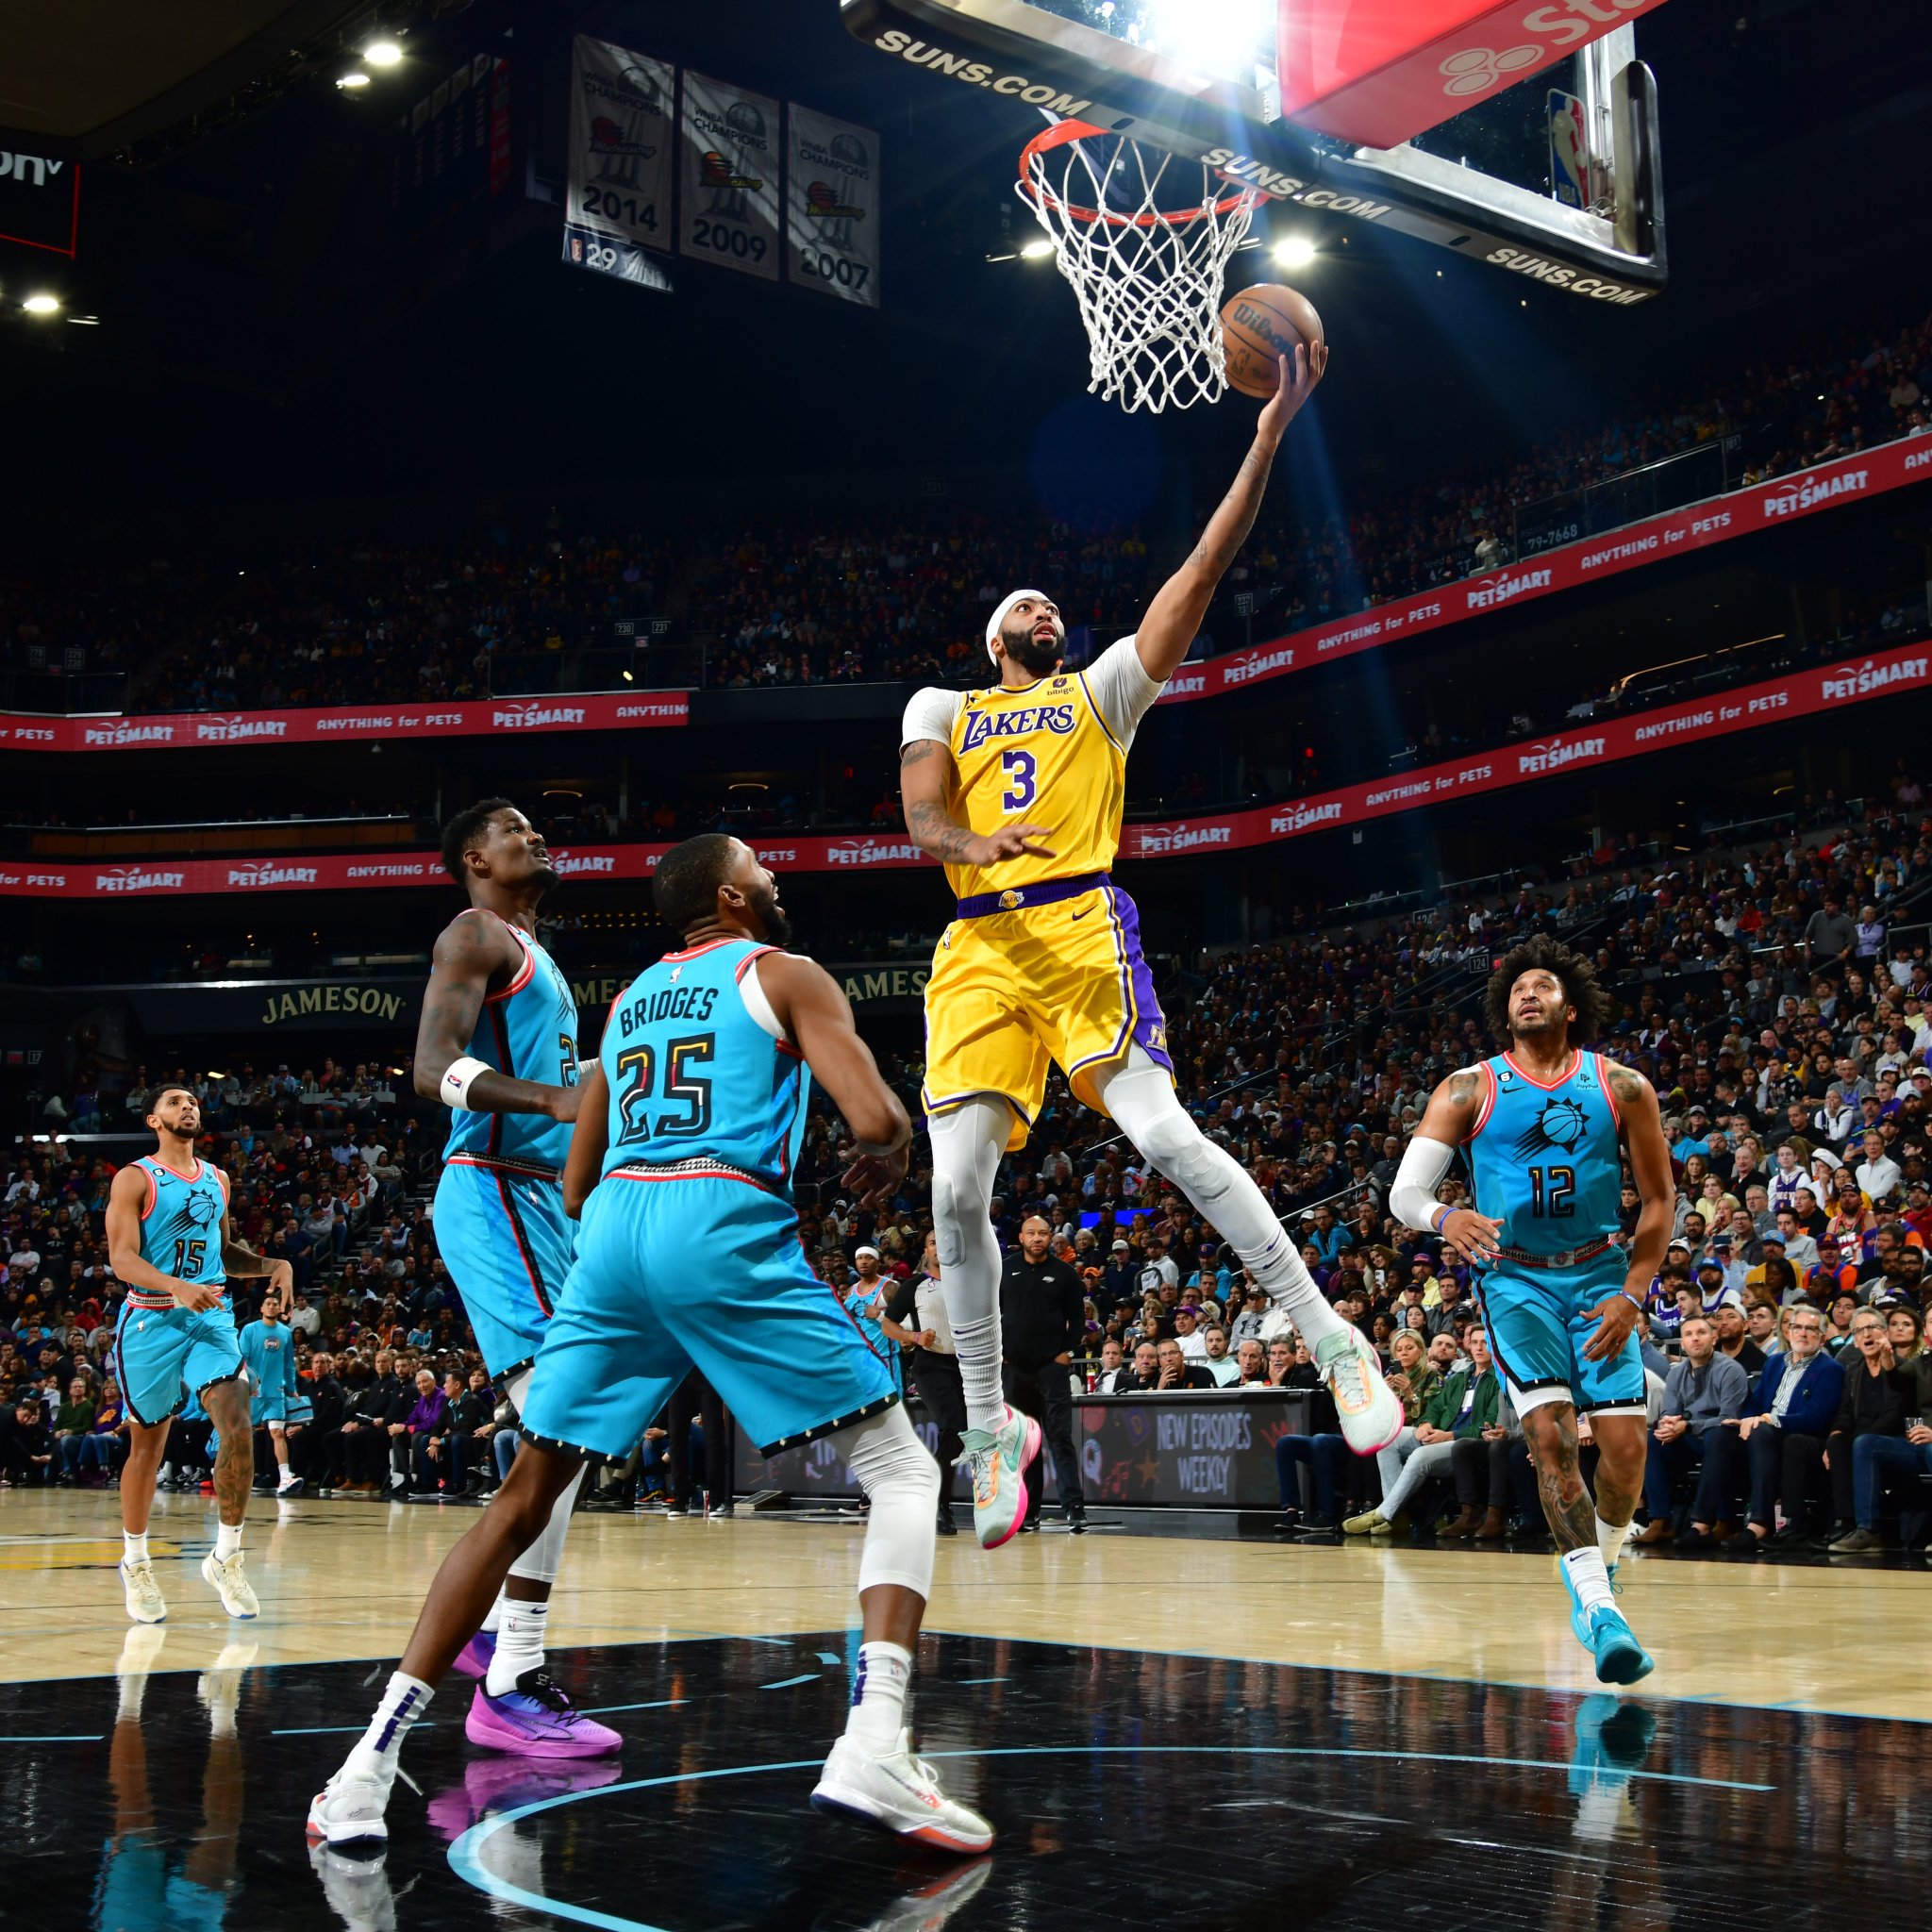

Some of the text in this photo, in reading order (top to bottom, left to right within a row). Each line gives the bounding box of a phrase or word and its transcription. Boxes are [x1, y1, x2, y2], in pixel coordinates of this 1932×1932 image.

[1523, 0, 1644, 44] St
[875, 30, 1091, 116] SUNS.COM
[584, 82, 661, 117] CHAMPIONS
[693, 118, 768, 151] CHAMPIONS
[800, 149, 870, 181] CHAMPIONS
[1200, 147, 1391, 221] SUNS.COM
[582, 185, 658, 232] 2014
[586, 242, 617, 271] 29
[692, 219, 767, 262] 2009
[801, 247, 870, 290] 2007
[1486, 247, 1650, 307] SUNS.COM
[1581, 513, 1730, 569] ANYTHING for PETS
[1317, 603, 1441, 651] ANYTHING for PETS
[1046, 685, 1074, 696] bibigo
[15, 728, 55, 741] PETS
[317, 713, 462, 730] ANYTHING for PETS
[958, 705, 1075, 756] LAKERS
[1636, 691, 1789, 741] ANYTHING for PETS
[1002, 750, 1036, 814] 3
[1366, 765, 1491, 807] ANYTHING for PETS
[26, 874, 65, 887] PETS
[347, 862, 444, 877] ANYTHING fo
[262, 987, 402, 1025] JAMESON
[621, 987, 718, 1039] BRIDGES
[559, 1033, 578, 1087] 2
[617, 1032, 716, 1147] 25
[1528, 1165, 1575, 1219] 12
[173, 1239, 207, 1278] 15
[1158, 1412, 1251, 1451] NEW EPISODES
[1177, 1456, 1231, 1495] WEEKLY
